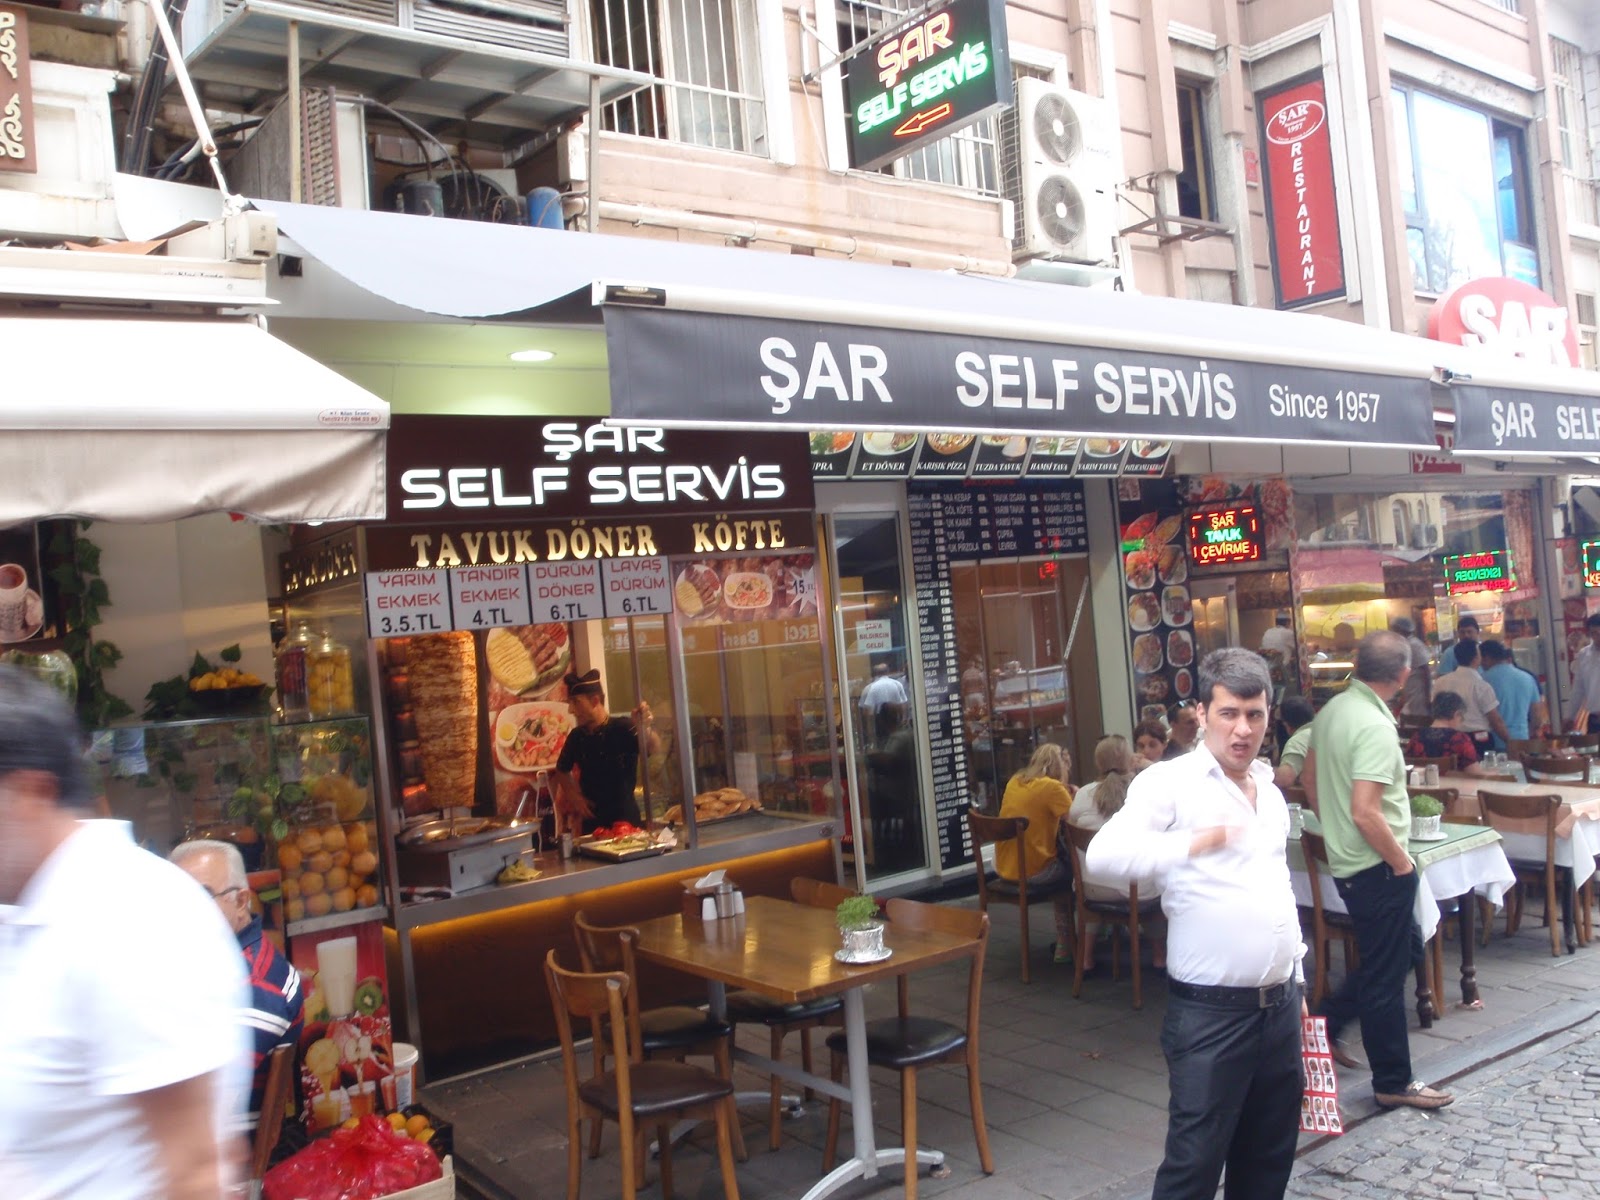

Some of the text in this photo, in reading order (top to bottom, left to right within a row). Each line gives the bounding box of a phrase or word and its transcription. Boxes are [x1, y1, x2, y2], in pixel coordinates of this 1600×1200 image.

[877, 12, 954, 88] ŞAR
[857, 41, 988, 133] SELF SERVİS
[1290, 142, 1316, 295] RESTAURANT
[759, 336, 1381, 423] ŞAR SELF SERVİS Since 1957
[1491, 399, 1537, 446] ŞAR
[541, 422, 666, 461] ŞAR
[862, 460, 905, 471] ET DÖNER
[999, 463, 1022, 472] TAVUK
[400, 455, 786, 509] SELF SERVİS
[1211, 514, 1234, 530] ŞAR
[411, 513, 786, 568] TAVUK DÖNER KÖFTE
[1204, 528, 1242, 543] TAVUK
[1200, 541, 1250, 560] ÇEVİRME
[535, 563, 594, 579] DÜRÜM
[610, 557, 662, 574] LAVAŞ
[378, 573, 436, 587] YARIM
[456, 567, 520, 583] TANDIR
[538, 582, 594, 599] DÖNER
[610, 576, 665, 593] DÜRÜM
[377, 592, 441, 609] EKMEK
[460, 587, 520, 604] EKMEK
[550, 602, 588, 620] 6.TL
[622, 596, 658, 614] 6.TL
[381, 613, 441, 633] 3.5.TL
[472, 607, 513, 626] 4.TL
